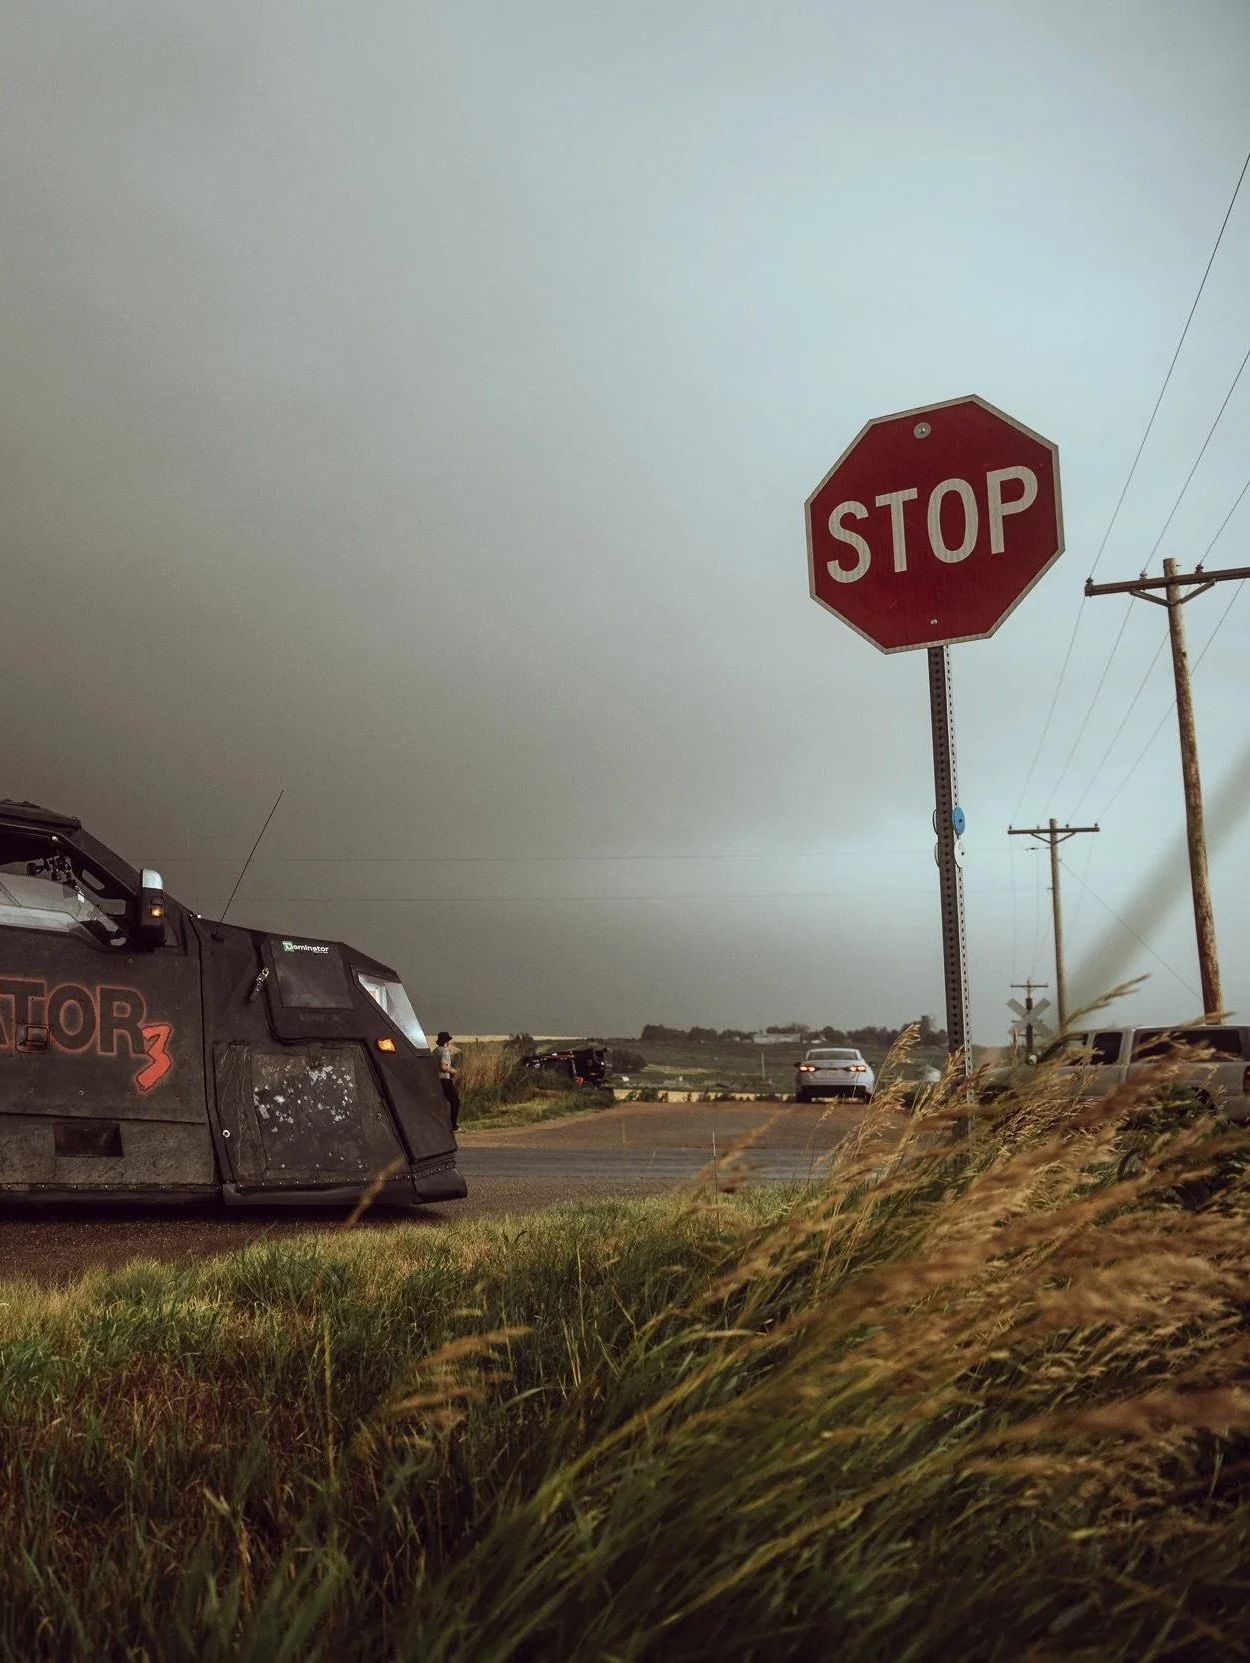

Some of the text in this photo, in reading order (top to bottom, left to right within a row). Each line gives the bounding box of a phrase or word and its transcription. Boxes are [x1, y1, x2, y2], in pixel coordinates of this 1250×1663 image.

[827, 465, 1038, 583] STOP
[282, 941, 329, 952] Dominator
[136, 1023, 172, 1093] 3
